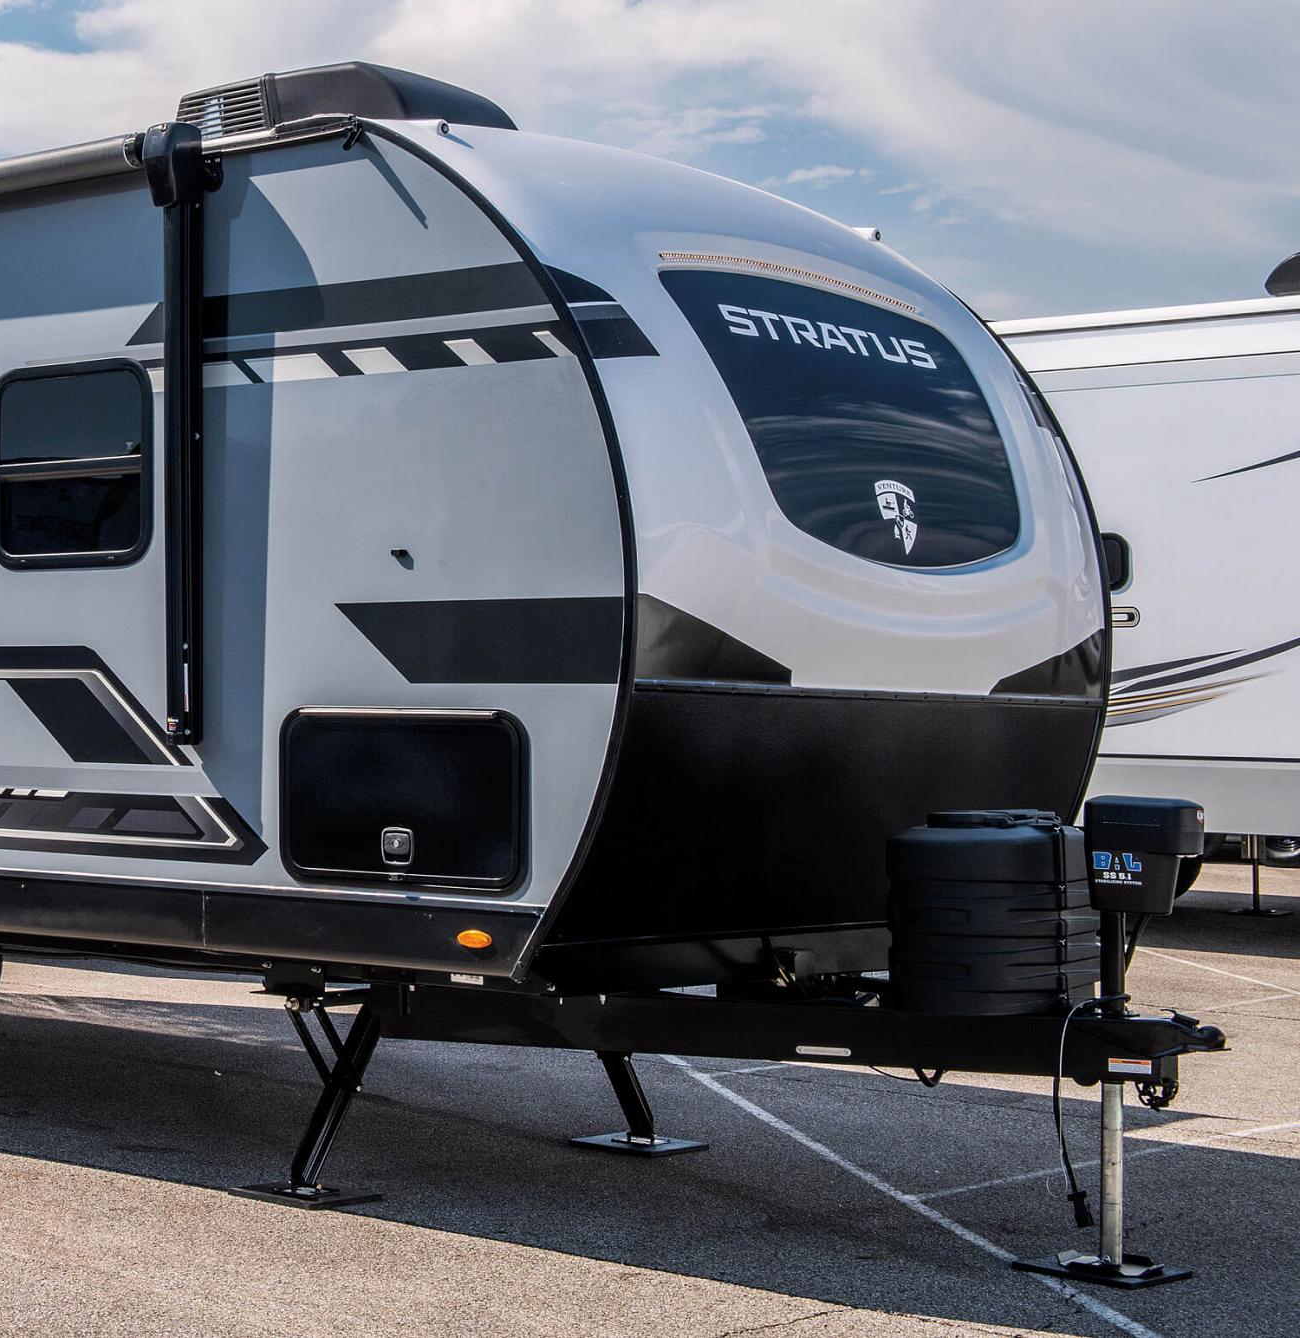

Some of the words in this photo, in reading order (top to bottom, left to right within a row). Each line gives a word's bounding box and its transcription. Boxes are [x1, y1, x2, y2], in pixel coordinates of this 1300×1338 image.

[717, 303, 938, 370] STRATUS
[876, 483, 913, 499] VENTURE
[1092, 851, 1142, 872] BAL
[1103, 871, 1117, 880] SS
